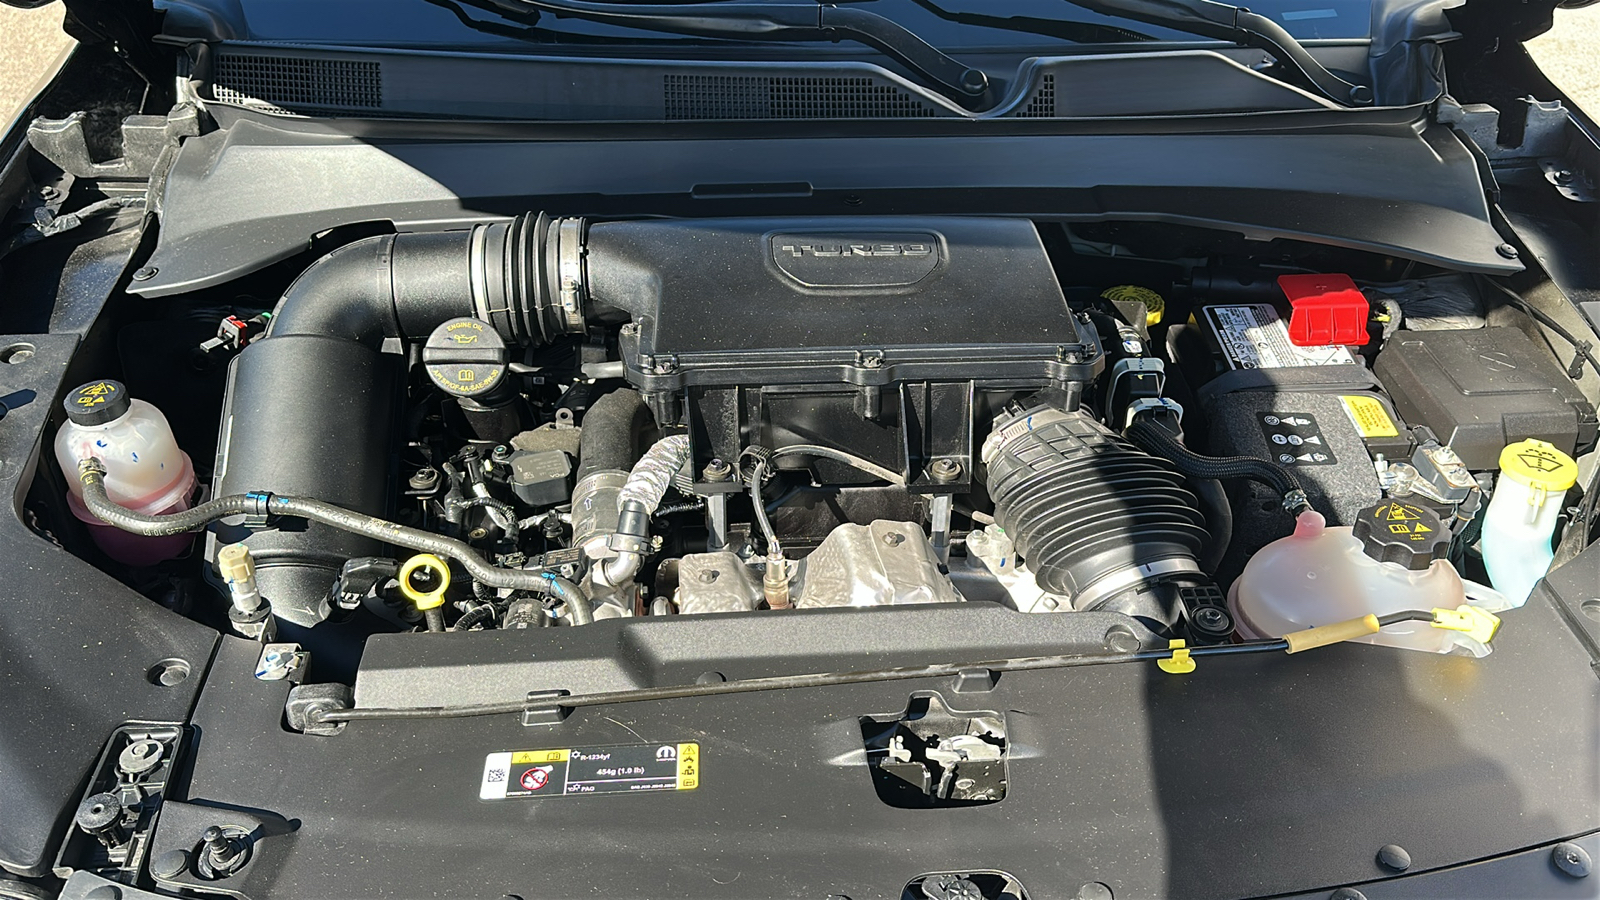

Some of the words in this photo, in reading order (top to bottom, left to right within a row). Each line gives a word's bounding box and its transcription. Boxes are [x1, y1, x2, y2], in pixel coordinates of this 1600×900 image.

[782, 244, 932, 257] TURBO
[446, 321, 472, 332] ENGINE
[472, 322, 483, 332] OIL
[432, 369, 443, 381] API
[580, 752, 611, 762] R-1234yf
[596, 767, 617, 777] 454g
[617, 766, 633, 776] (1.0
[633, 766, 645, 776] lb)
